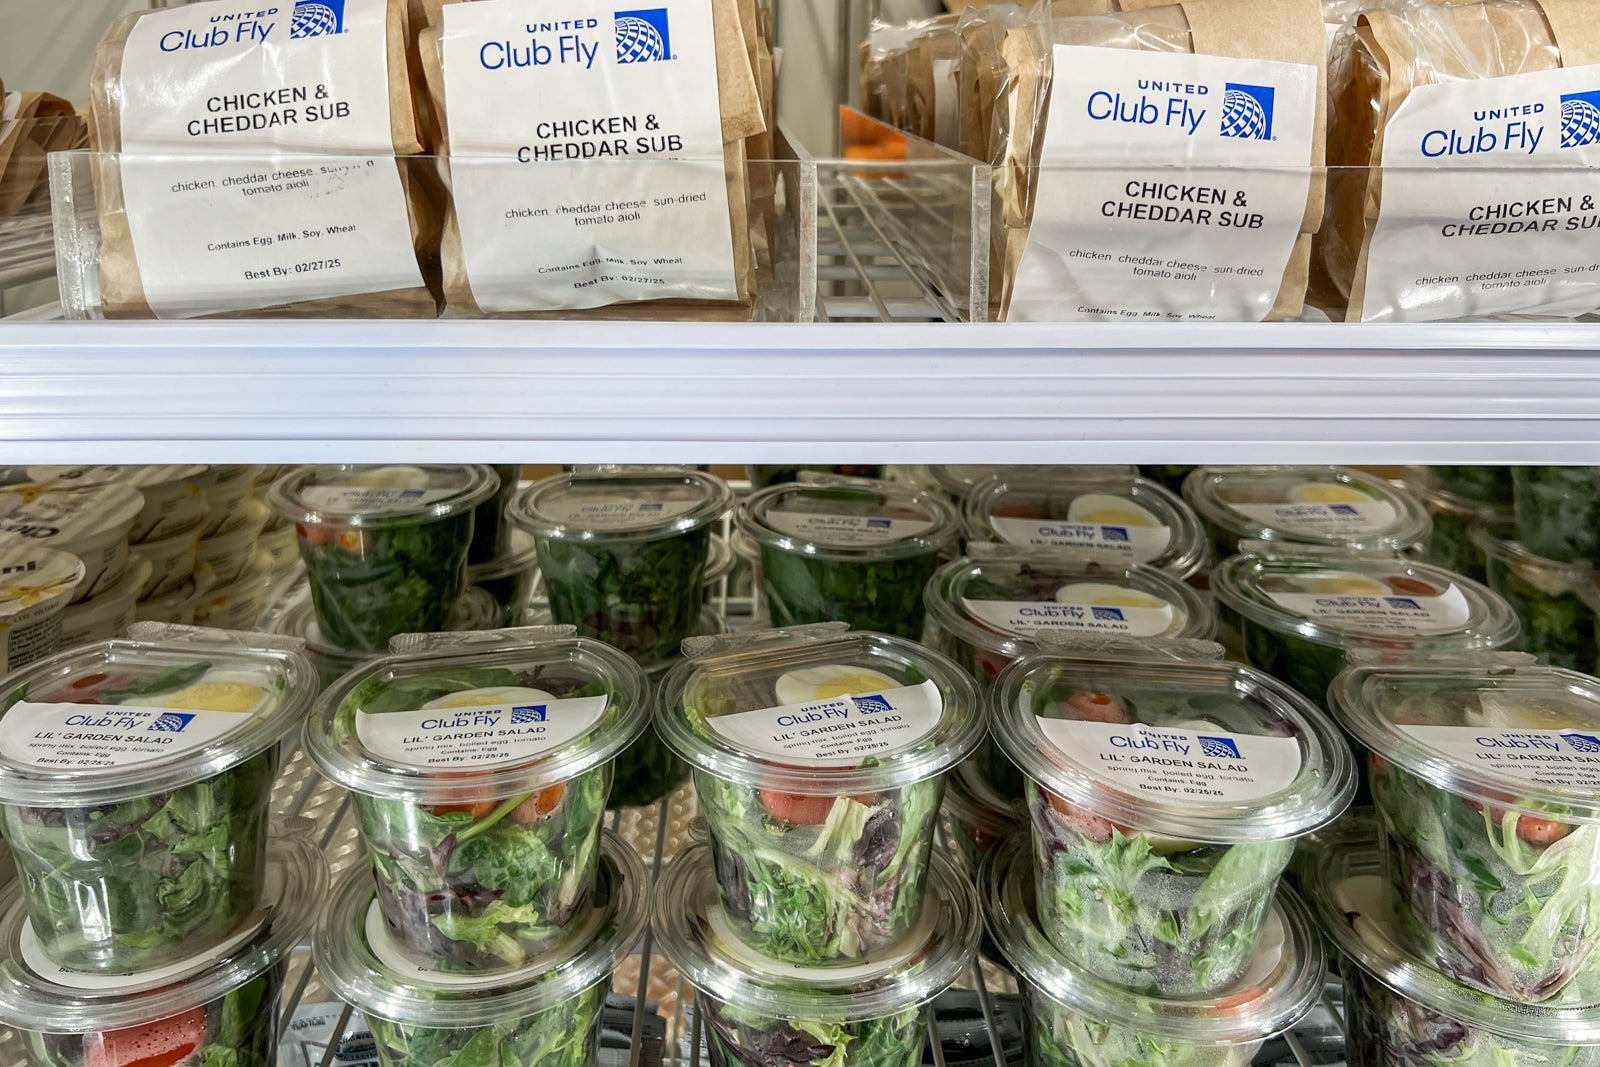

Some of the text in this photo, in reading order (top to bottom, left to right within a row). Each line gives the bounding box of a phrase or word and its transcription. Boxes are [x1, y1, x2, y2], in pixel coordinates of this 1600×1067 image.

[210, 8, 278, 23] UNITED
[526, 18, 598, 33] UNITED
[160, 21, 276, 52] Club Fly
[480, 36, 599, 70] Club Fly
[1138, 80, 1209, 95] UNITED
[207, 84, 329, 113] CHICKEN &
[188, 101, 350, 136] CHEDDAR SUB
[1087, 91, 1206, 135] Club Fly
[1474, 103, 1545, 121] UNITED
[536, 114, 660, 140] CHICKEN &
[1421, 122, 1544, 158] Club Fly
[518, 135, 683, 163] CHEDDAR SUB
[222, 172, 268, 187] cheddar
[242, 180, 310, 196] tomato aioli
[1126, 180, 1248, 207] CHICKEN &
[556, 204, 601, 215] cheddar
[654, 192, 706, 206] sun-dried
[1468, 194, 1594, 221] CHICKEN &
[575, 212, 640, 226] tomato aioli
[1102, 201, 1264, 230] CHEDDAR SUB
[1442, 216, 1600, 238] CHEDDAR SU
[208, 239, 250, 252] Contains
[326, 224, 356, 234] Wheat
[244, 258, 341, 280] Best By: 02/27/25
[538, 264, 580, 274] Contains
[1118, 254, 1163, 266] cheddar
[1214, 266, 1264, 276] sun-dried
[1134, 267, 1197, 281] tomato aioli
[1466, 272, 1513, 282] cheddar
[574, 278, 598, 289] Best
[1482, 278, 1546, 290] tomato aioli
[1078, 306, 1118, 315] Contains
[1039, 527, 1095, 540] Club Fly
[1020, 608, 1084, 619] Club Fly
[1088, 622, 1128, 630] SALAD
[454, 709, 502, 717] UNITED
[801, 702, 844, 712] UNITED
[66, 714, 144, 730] Club Fly
[421, 715, 501, 730] Club Fly
[776, 706, 849, 726] Club Fly
[403, 727, 546, 744] LIL' GARDEN SALAD
[773, 715, 902, 742] LIL' GARDEN SALAD
[1139, 730, 1188, 741] UNITED
[63, 732, 124, 742] GARDEN
[125, 736, 173, 745] SALAD
[1110, 736, 1190, 755] Club Fly
[1476, 737, 1560, 752] Club Fly
[816, 750, 836, 758] Best
[1475, 752, 1501, 760] LIL'
[1506, 754, 1572, 762] GARDEN
[1100, 753, 1248, 772] LIL' GARDEN SALAD
